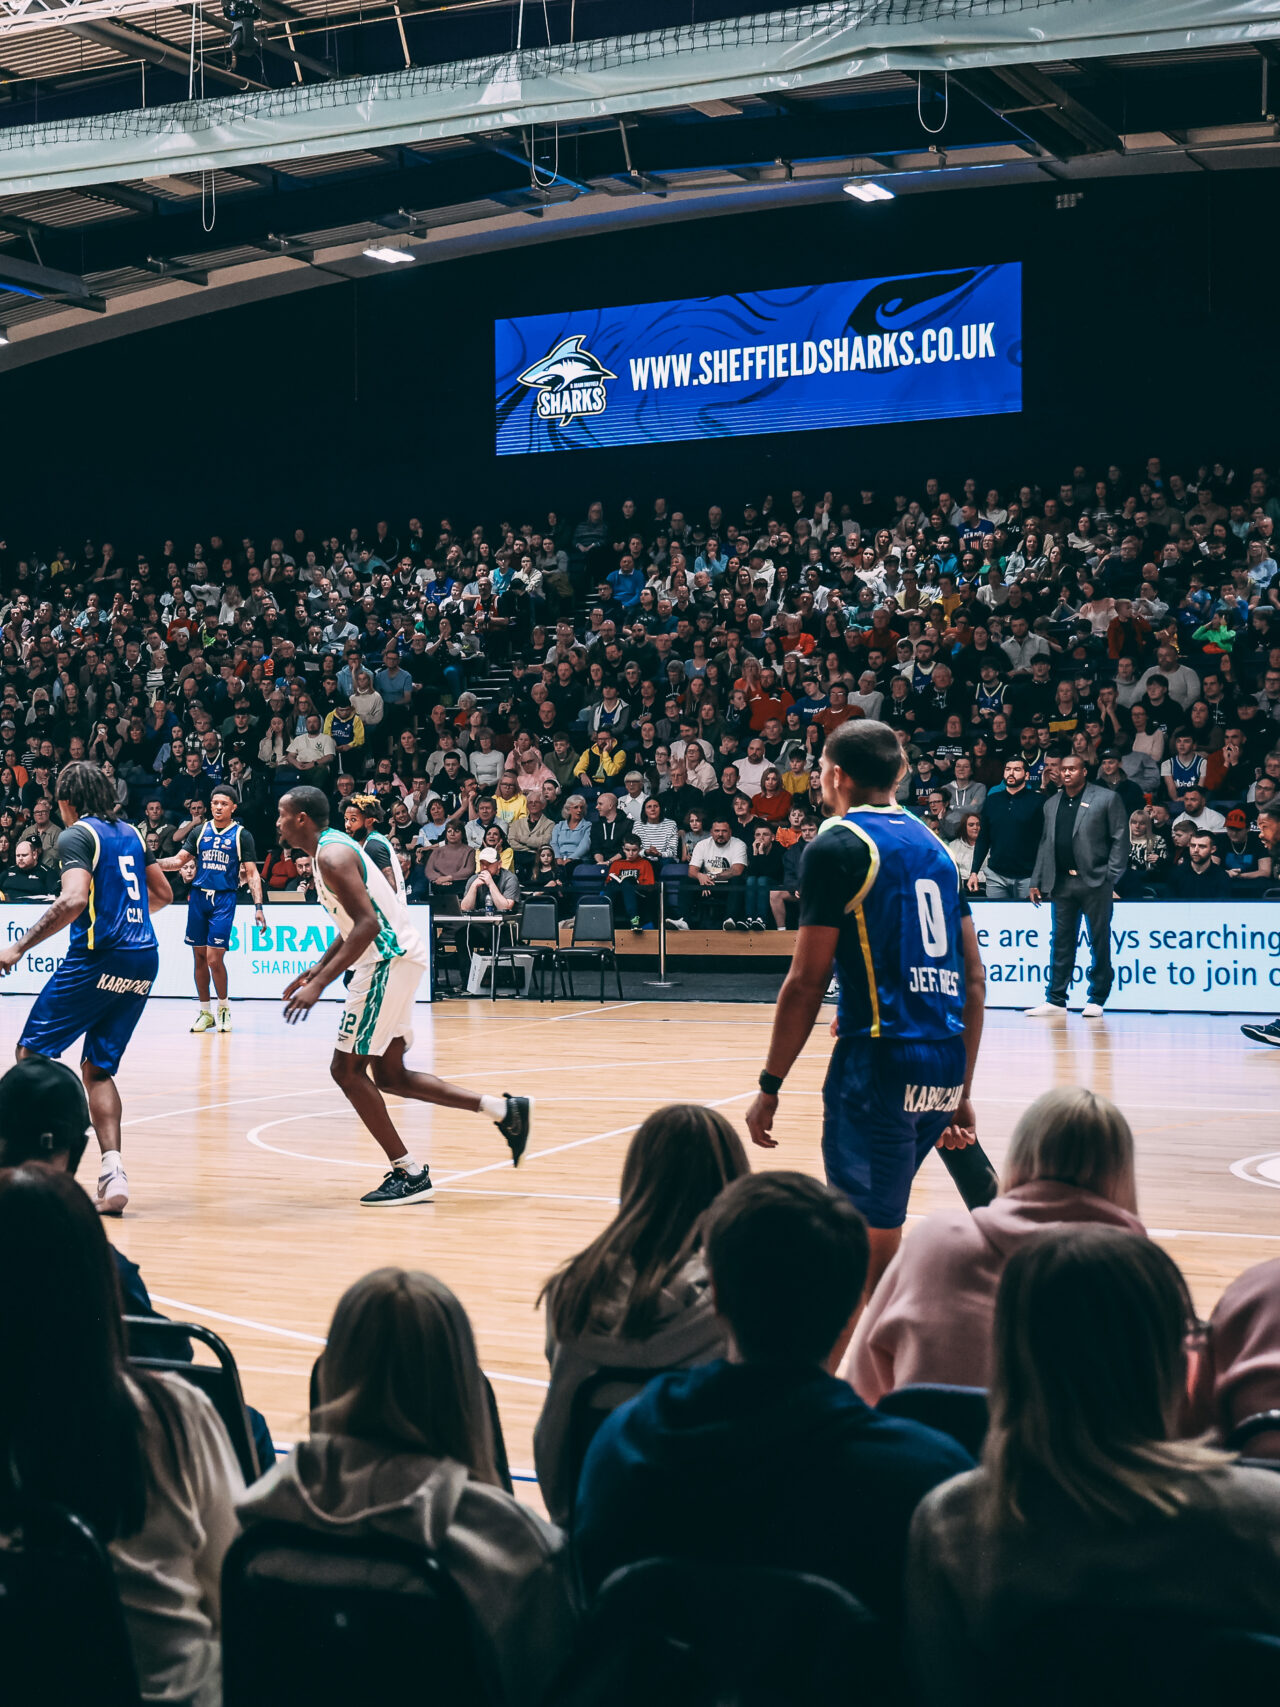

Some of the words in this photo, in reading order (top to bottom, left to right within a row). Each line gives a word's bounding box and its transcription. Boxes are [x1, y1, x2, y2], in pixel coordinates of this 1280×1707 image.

[629, 321, 996, 391] WWW.SHEFFIELDSHARKS.CO.UK
[540, 387, 603, 415] SHARKS
[201, 849, 230, 864] SHEFFIELD
[212, 837, 221, 849] 2
[117, 855, 141, 901] 5
[7, 920, 31, 942] fo
[914, 878, 948, 958] 0
[976, 929, 990, 947] e
[999, 929, 1039, 948] are
[1149, 924, 1280, 957] searching
[1069, 958, 1157, 991] pple
[1168, 961, 1196, 985] to
[1203, 960, 1257, 992] join
